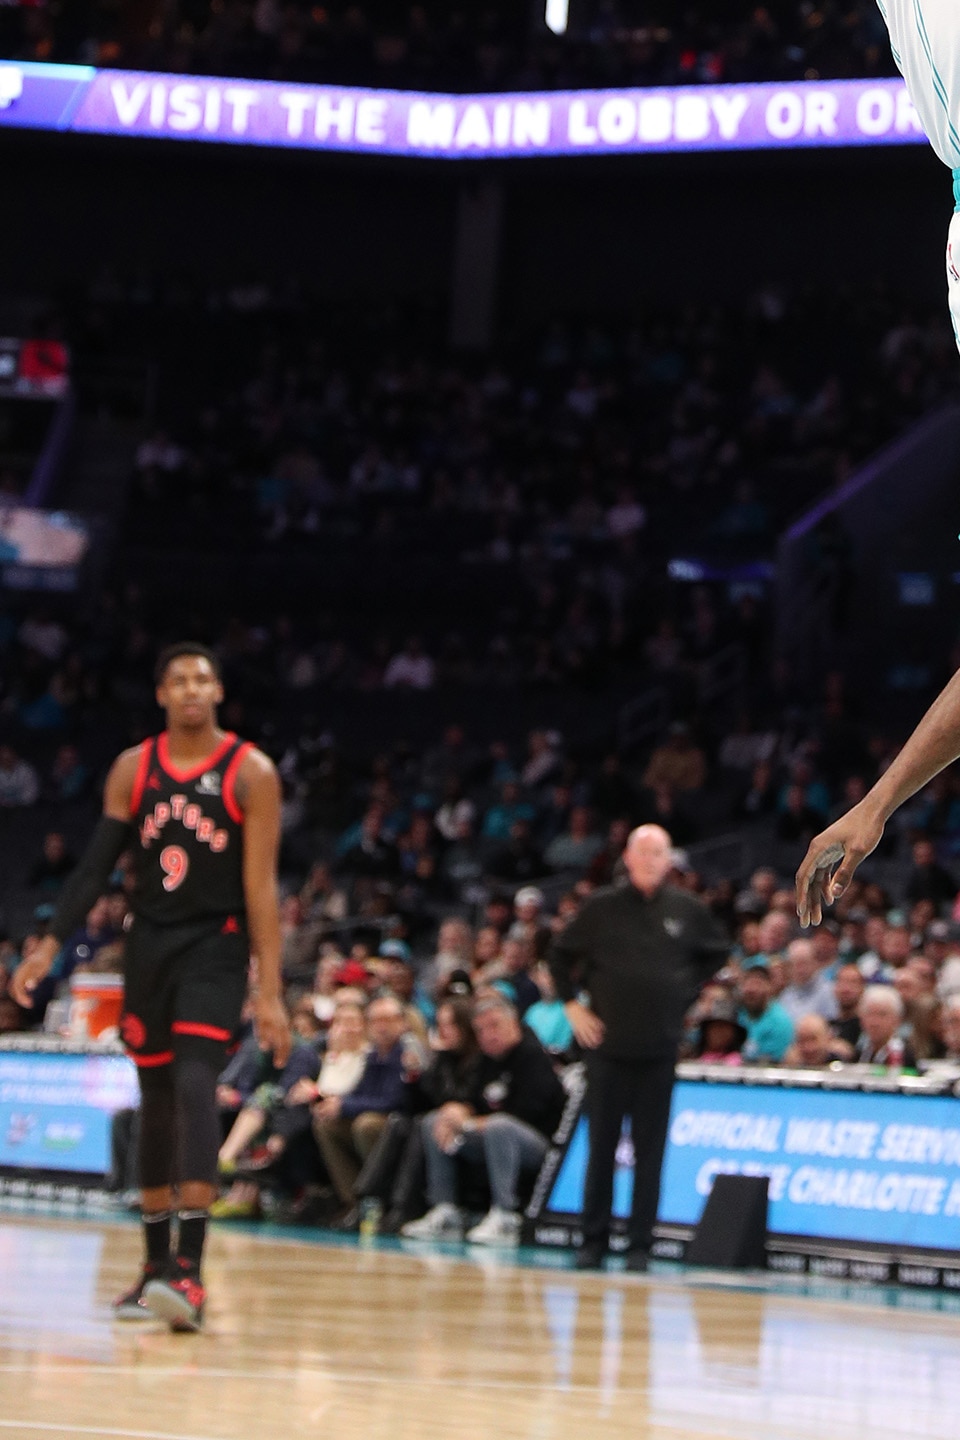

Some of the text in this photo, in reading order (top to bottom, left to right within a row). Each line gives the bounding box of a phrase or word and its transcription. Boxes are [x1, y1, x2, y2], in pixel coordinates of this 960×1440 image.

[110, 80, 260, 133] VISIT
[279, 92, 390, 145] THE
[405, 100, 551, 150] MAIN
[567, 95, 750, 145] LOBBY
[764, 91, 838, 140] OR
[160, 844, 189, 892] 9
[669, 1109, 782, 1153] OFFICIAL
[788, 1165, 948, 1216] CHARLOTTE
